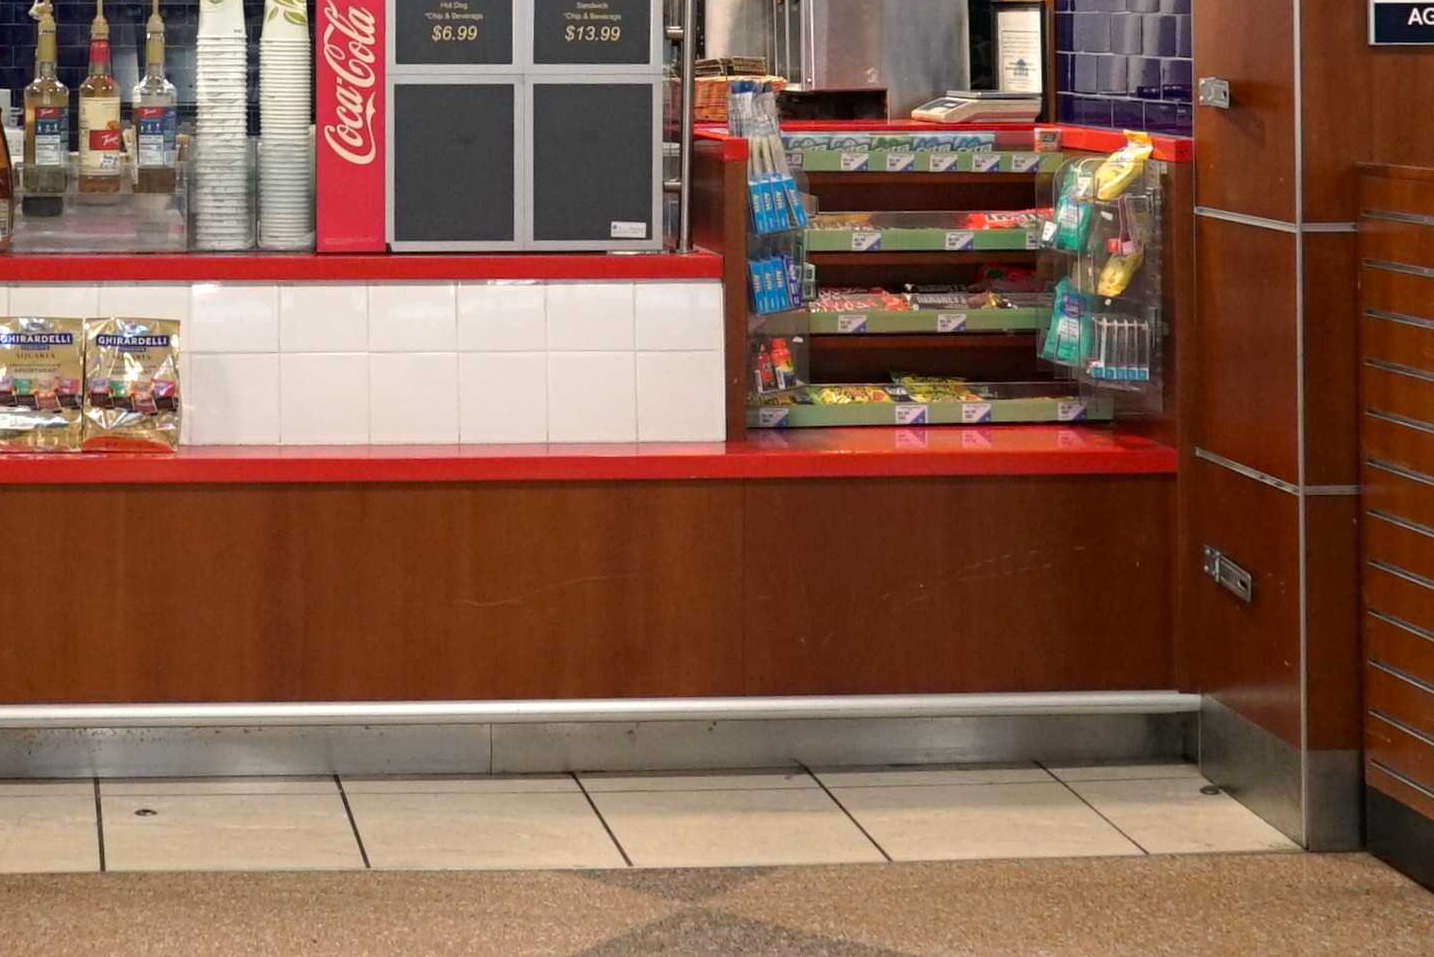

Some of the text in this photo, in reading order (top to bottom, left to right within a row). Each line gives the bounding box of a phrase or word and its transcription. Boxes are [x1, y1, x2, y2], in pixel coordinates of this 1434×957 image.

[454, 2, 468, 10] Dog
[451, 12, 484, 21] Beverage
[589, 12, 622, 21] Beverage
[432, 25, 478, 42] $6.99
[565, 25, 621, 42] $13.99
[0, 334, 71, 343] GHIRARDELLI
[98, 336, 167, 345] GHIRARDELLI
